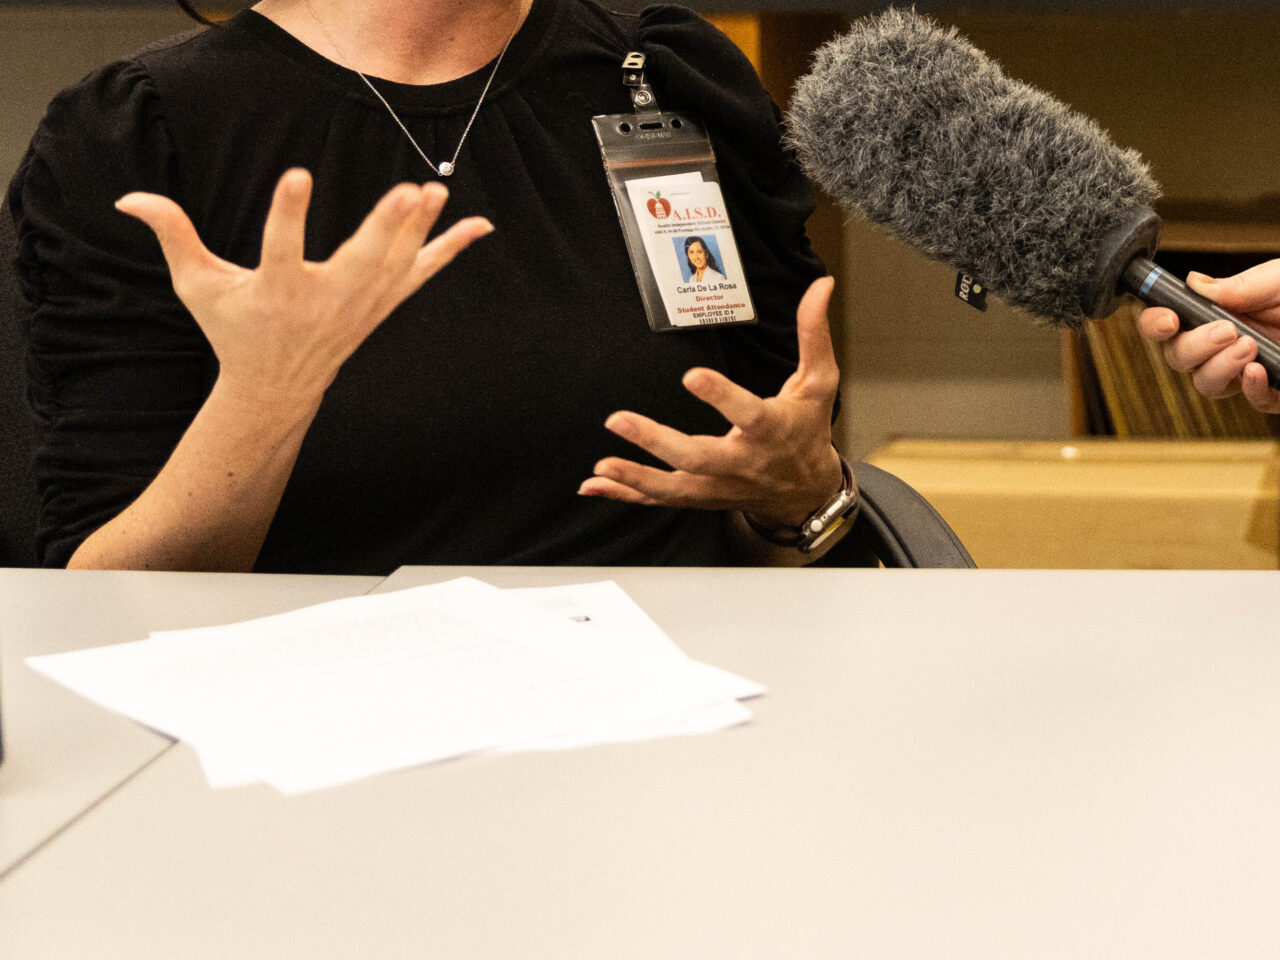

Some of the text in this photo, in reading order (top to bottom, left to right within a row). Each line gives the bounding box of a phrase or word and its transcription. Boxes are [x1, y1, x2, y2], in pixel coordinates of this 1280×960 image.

[672, 206, 722, 221] A.I.S.D.
[677, 286, 696, 294] Carla
[697, 284, 708, 292] De
[708, 283, 718, 291] La
[959, 275, 972, 301] RØD
[696, 294, 724, 302] Director
[677, 303, 746, 314] Student Attendance
